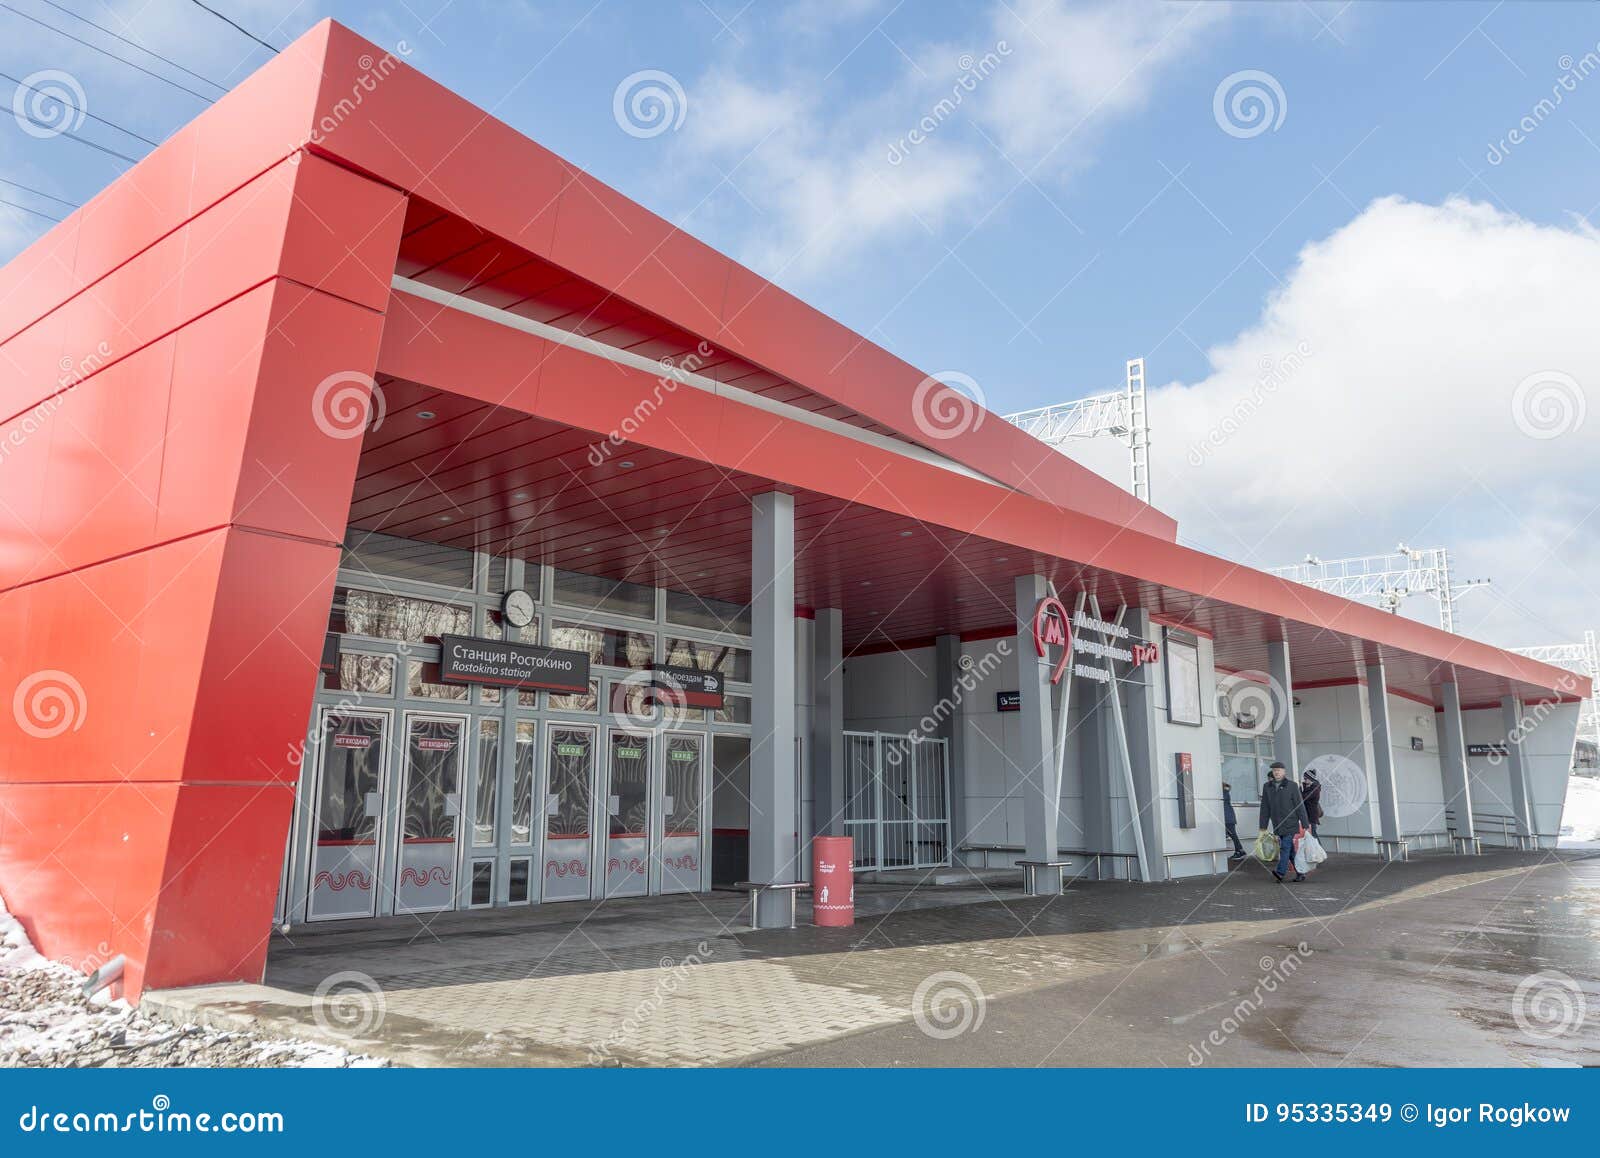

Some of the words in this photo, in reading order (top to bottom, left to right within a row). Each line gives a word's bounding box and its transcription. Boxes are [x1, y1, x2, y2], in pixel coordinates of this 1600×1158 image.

[1074, 611, 1129, 639] Московское
[453, 645, 507, 664] Станция
[510, 651, 572, 671] Ростокино
[1074, 638, 1132, 662] центральное
[452, 661, 499, 675] Rostokino
[500, 665, 531, 679] station
[672, 673, 702, 683] поездам
[1075, 663, 1110, 684] кольцо
[620, 750, 639, 758] ВХОД
